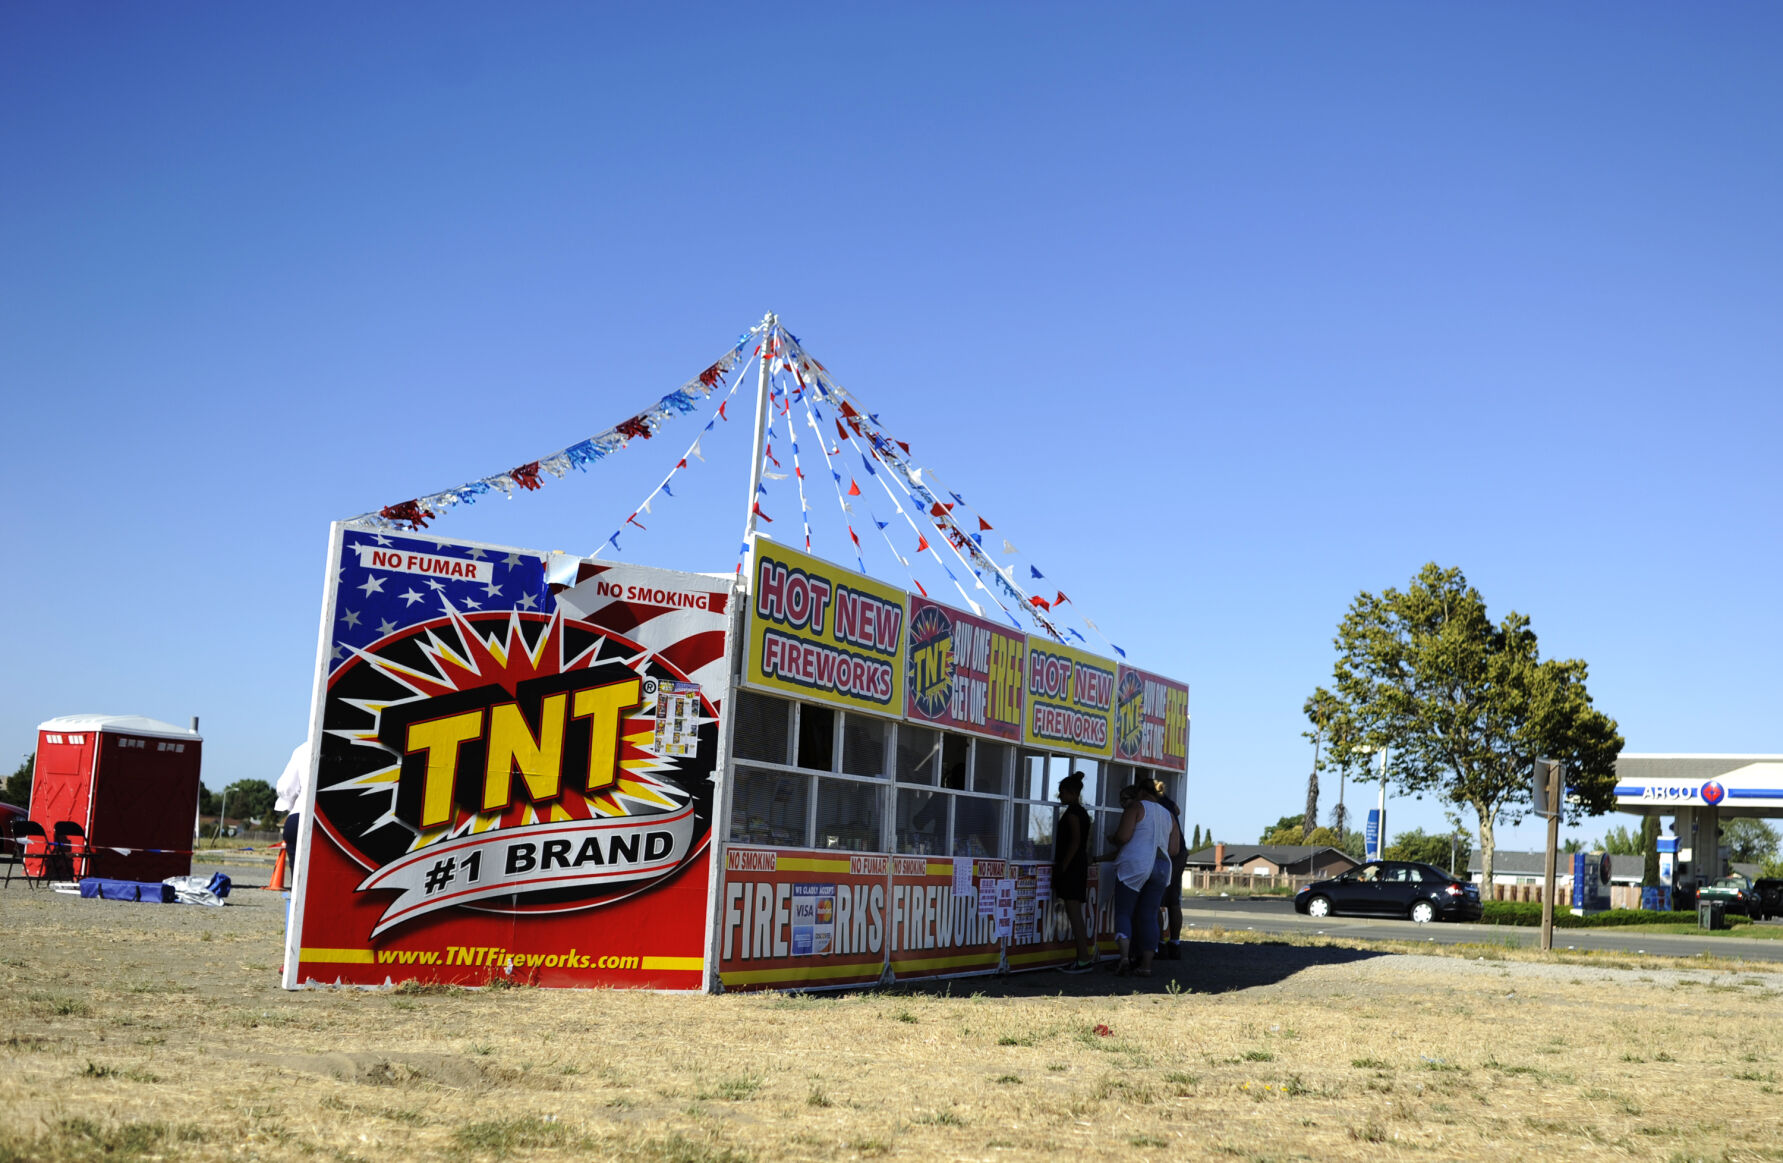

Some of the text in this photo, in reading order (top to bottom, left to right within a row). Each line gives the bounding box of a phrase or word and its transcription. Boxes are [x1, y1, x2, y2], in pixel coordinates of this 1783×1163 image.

[372, 551, 477, 579] NO FUMAR
[597, 581, 708, 610] NO SMOKING
[758, 561, 902, 652] HOT NEW
[764, 632, 892, 699] FIREWORKS
[914, 636, 952, 692] TNT
[954, 620, 990, 674] BUY ONE
[952, 674, 987, 726] GET ONE
[987, 632, 1023, 725] FREE
[1030, 652, 1114, 709] HOT NEW
[1033, 704, 1107, 746] FIREWORKS
[1120, 692, 1143, 740] TNT
[1164, 687, 1188, 758] FREE
[404, 676, 642, 830] TNT
[1642, 787, 1692, 800] ARCO
[423, 831, 674, 895] #1 BRAND
[728, 851, 776, 871] NO SMOKING
[851, 857, 887, 874] NO FUMAR
[893, 859, 926, 876] NO SMOKING
[979, 862, 986, 877] NO
[723, 882, 884, 960] FIRERKS
[796, 904, 814, 917] VISA
[377, 946, 639, 970] www.TNTFireworks.com
